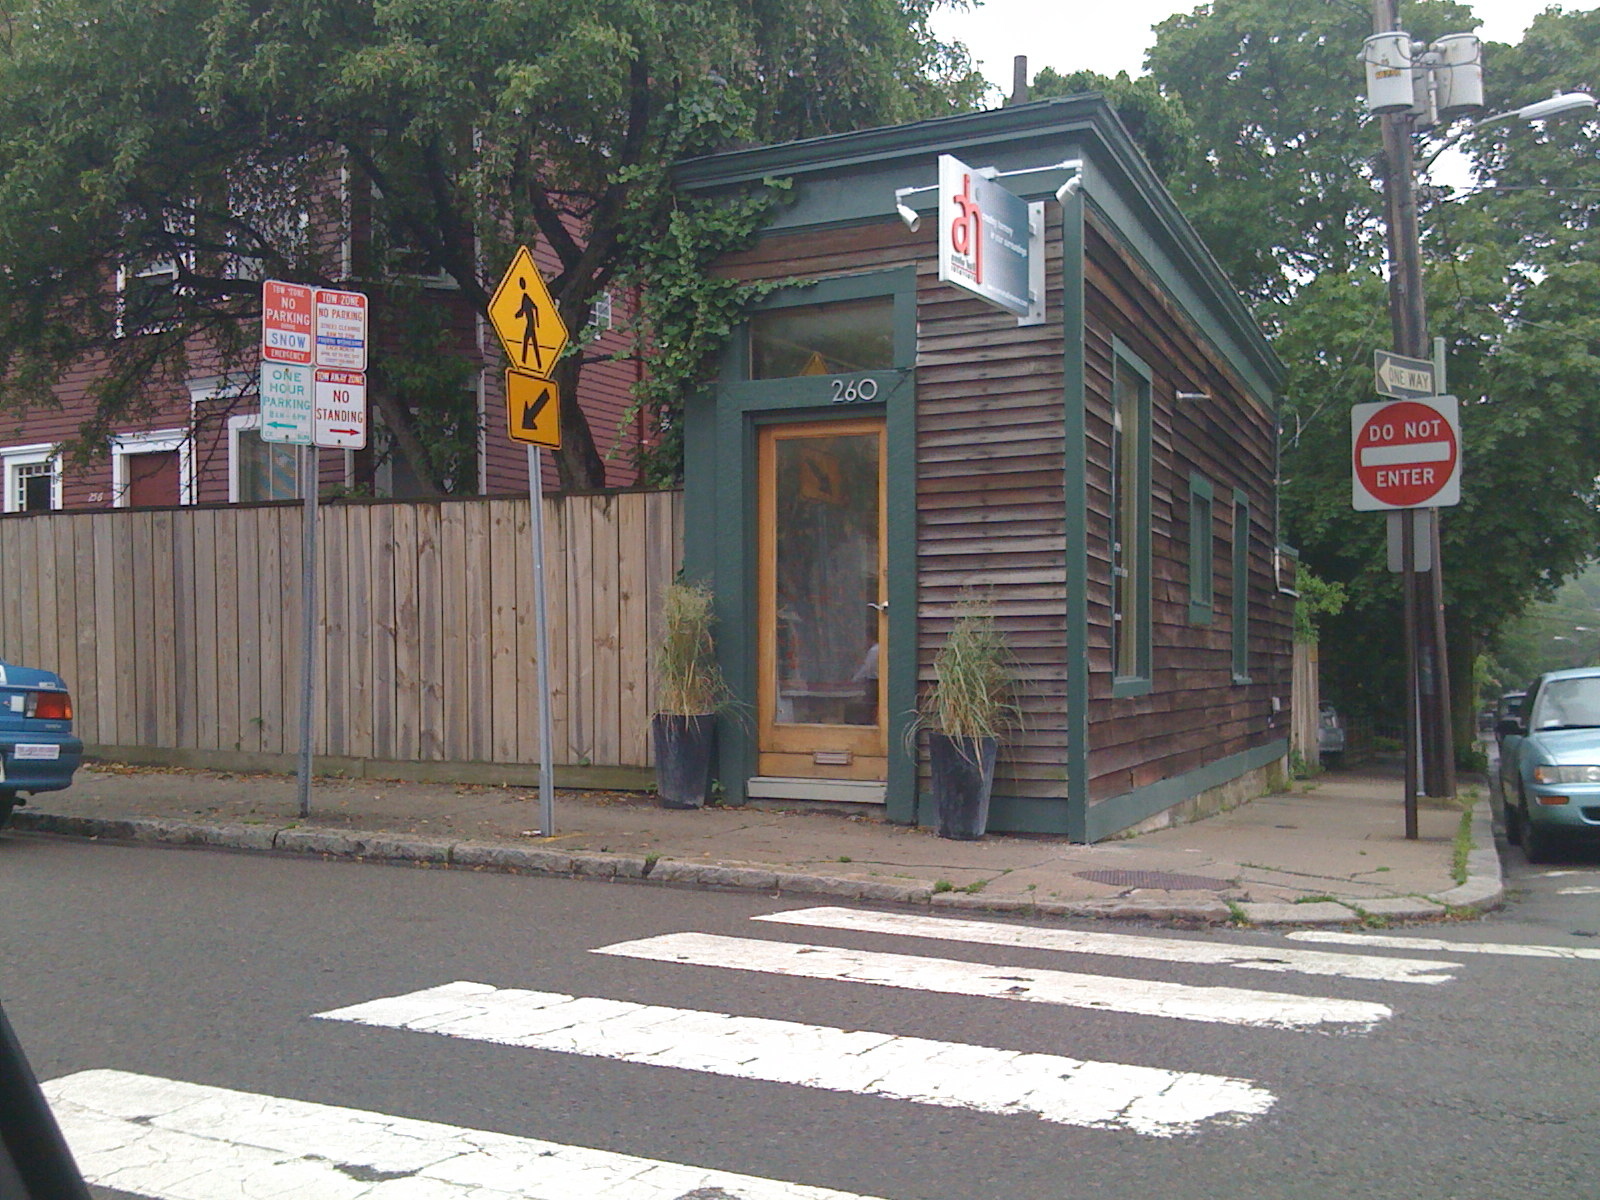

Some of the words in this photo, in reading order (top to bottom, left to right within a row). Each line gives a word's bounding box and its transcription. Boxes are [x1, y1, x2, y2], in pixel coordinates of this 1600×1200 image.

[272, 285, 286, 295] TOW
[288, 287, 304, 298] ZONE
[281, 297, 296, 310] NO
[322, 292, 338, 304] TOW
[340, 294, 360, 307] ZONE
[266, 308, 310, 326] PARKING
[318, 307, 329, 318] NO
[331, 309, 363, 322] PARKING
[271, 332, 306, 349] SNOW
[271, 348, 305, 361] EMERGENCY
[272, 370, 302, 383] ONE
[316, 371, 330, 382] TOW
[330, 373, 348, 384] AWAY
[347, 374, 364, 385] ZONE
[1388, 367, 1406, 384] ONE
[1407, 371, 1430, 389] WAY
[269, 382, 305, 396] HOUR
[831, 378, 878, 402] 260
[262, 395, 311, 411] PARKING
[333, 390, 350, 404] NO
[316, 407, 364, 424] STANDING
[1369, 424, 1395, 442] DO
[1404, 419, 1442, 439] NOT
[1376, 467, 1435, 488] ENTER
